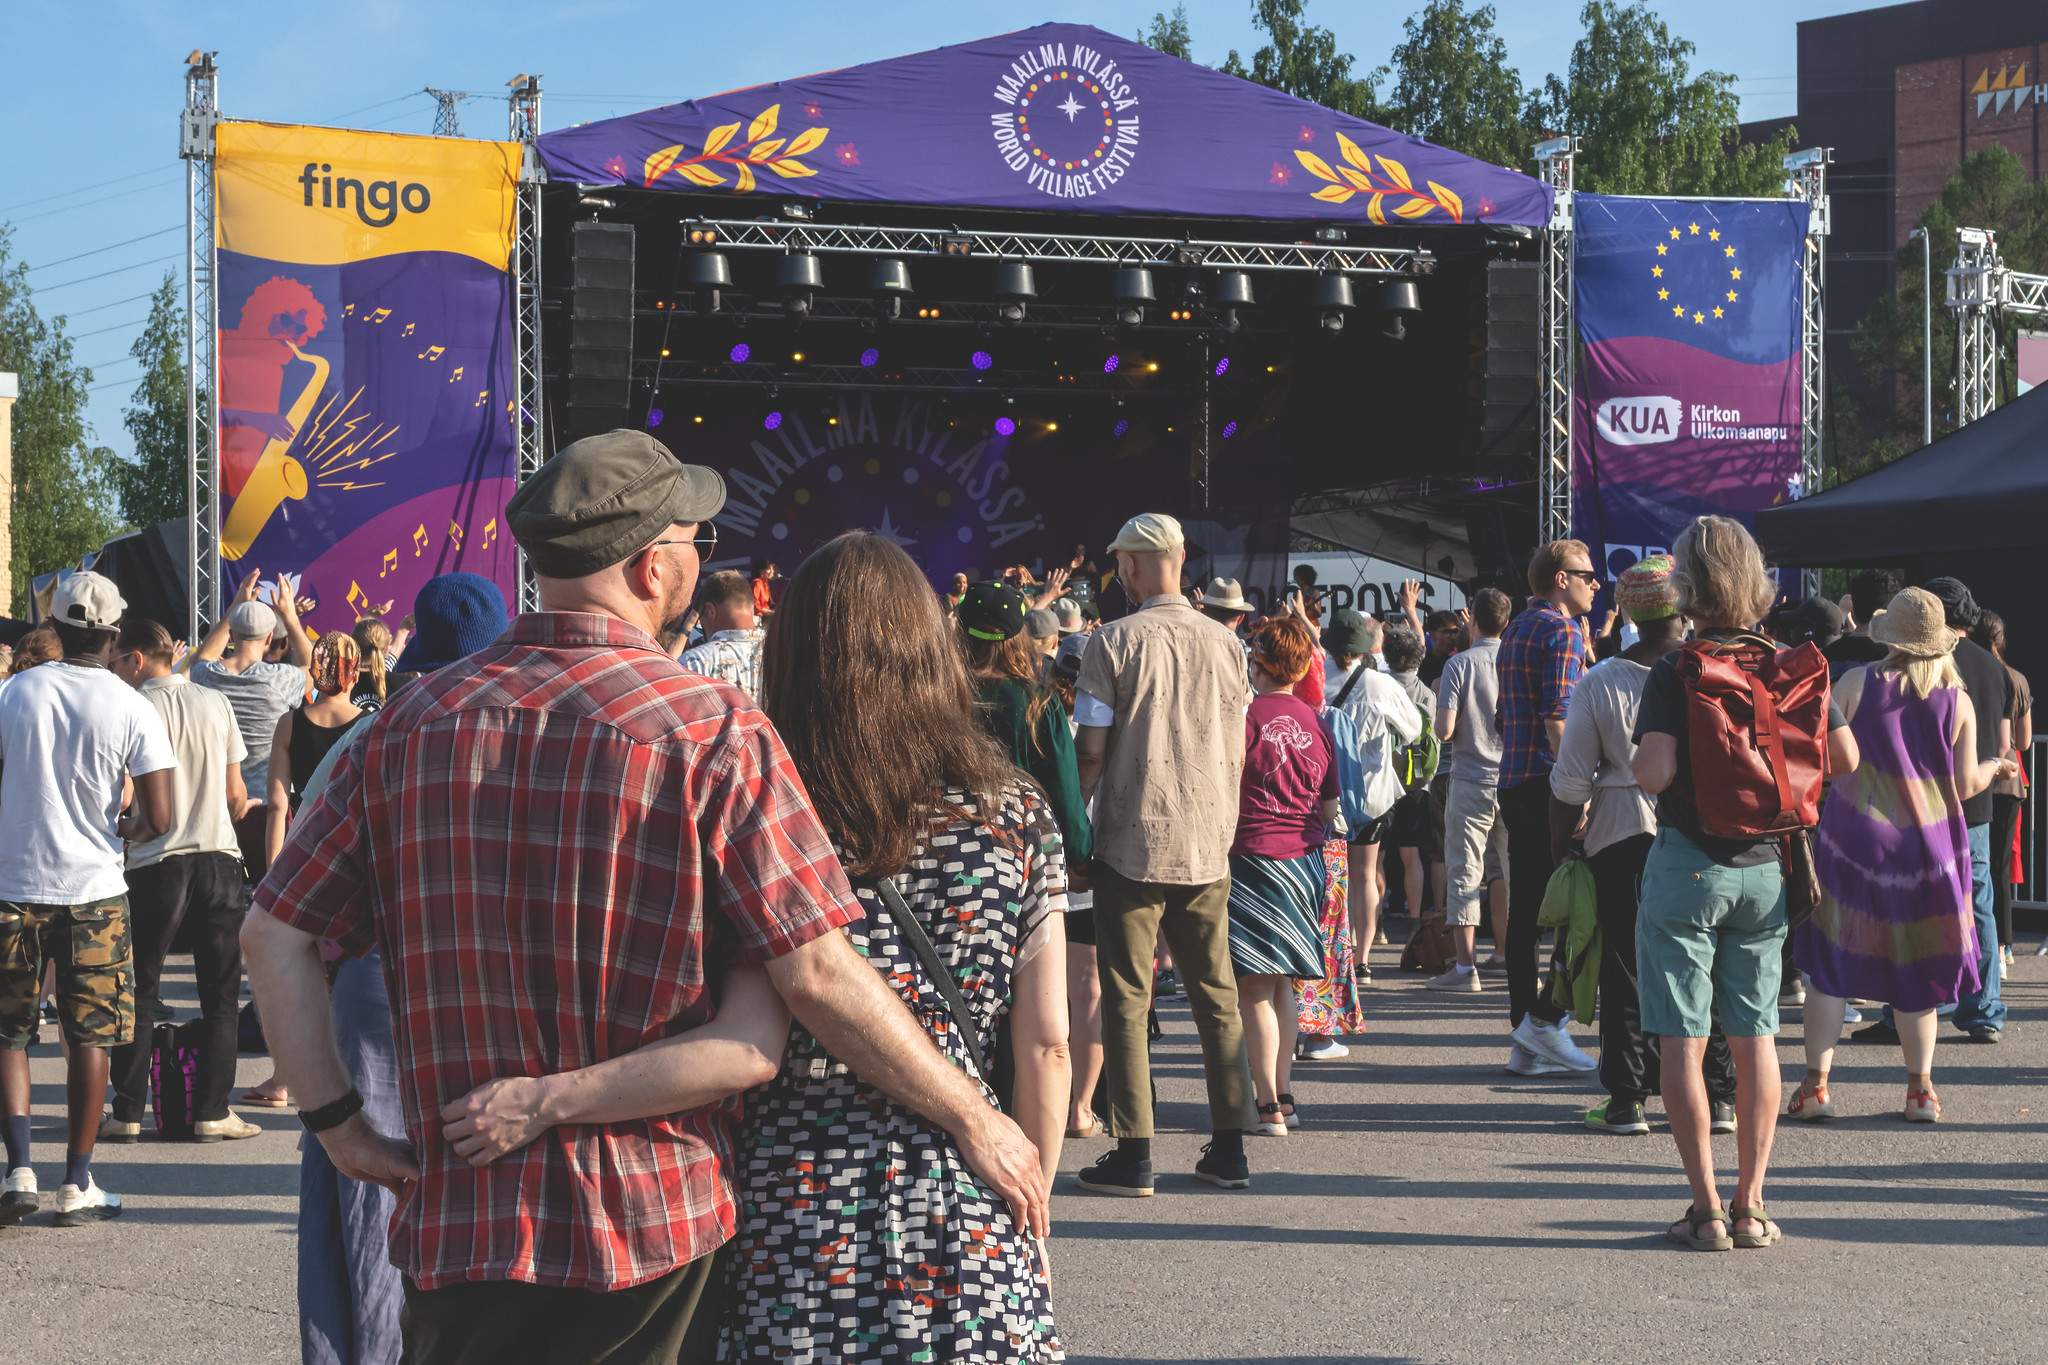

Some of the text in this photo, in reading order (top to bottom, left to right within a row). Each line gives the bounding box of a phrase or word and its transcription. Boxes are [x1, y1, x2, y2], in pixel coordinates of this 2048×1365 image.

[993, 42, 1139, 112] MAAILMA KYLÄSSÄ
[991, 112, 1139, 198] WORLD VILLAGE FESTIVAL
[298, 163, 431, 228] fingo
[1610, 404, 1670, 435] KUA
[1691, 404, 1741, 423] Kirkon
[1691, 422, 1787, 444] Ulkomaanapu
[713, 392, 880, 538] MAAILMA
